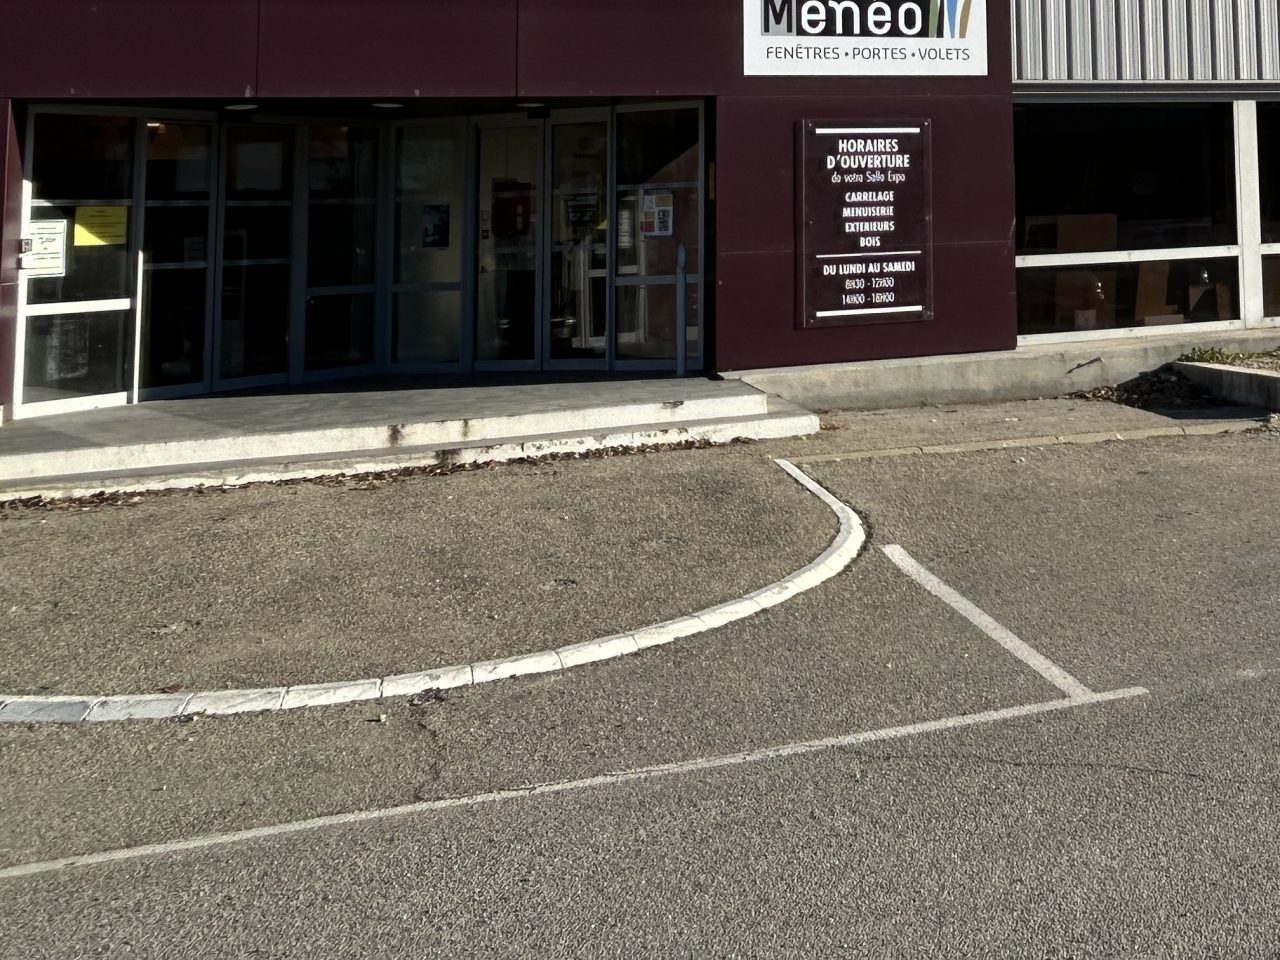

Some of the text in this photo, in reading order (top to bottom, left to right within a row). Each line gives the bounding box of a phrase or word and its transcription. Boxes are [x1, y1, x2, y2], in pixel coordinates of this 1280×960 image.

[765, 43, 971, 61] FENÊTRES PORTES VOLETS
[838, 138, 899, 153] HORAIRES
[826, 154, 910, 169] D'OUVERTURE
[845, 190, 895, 202] CARRELAGE
[842, 205, 895, 217] MENUISERIE
[859, 236, 881, 247] BOIS
[823, 260, 916, 276] DU LUNDI AU SAMEDI
